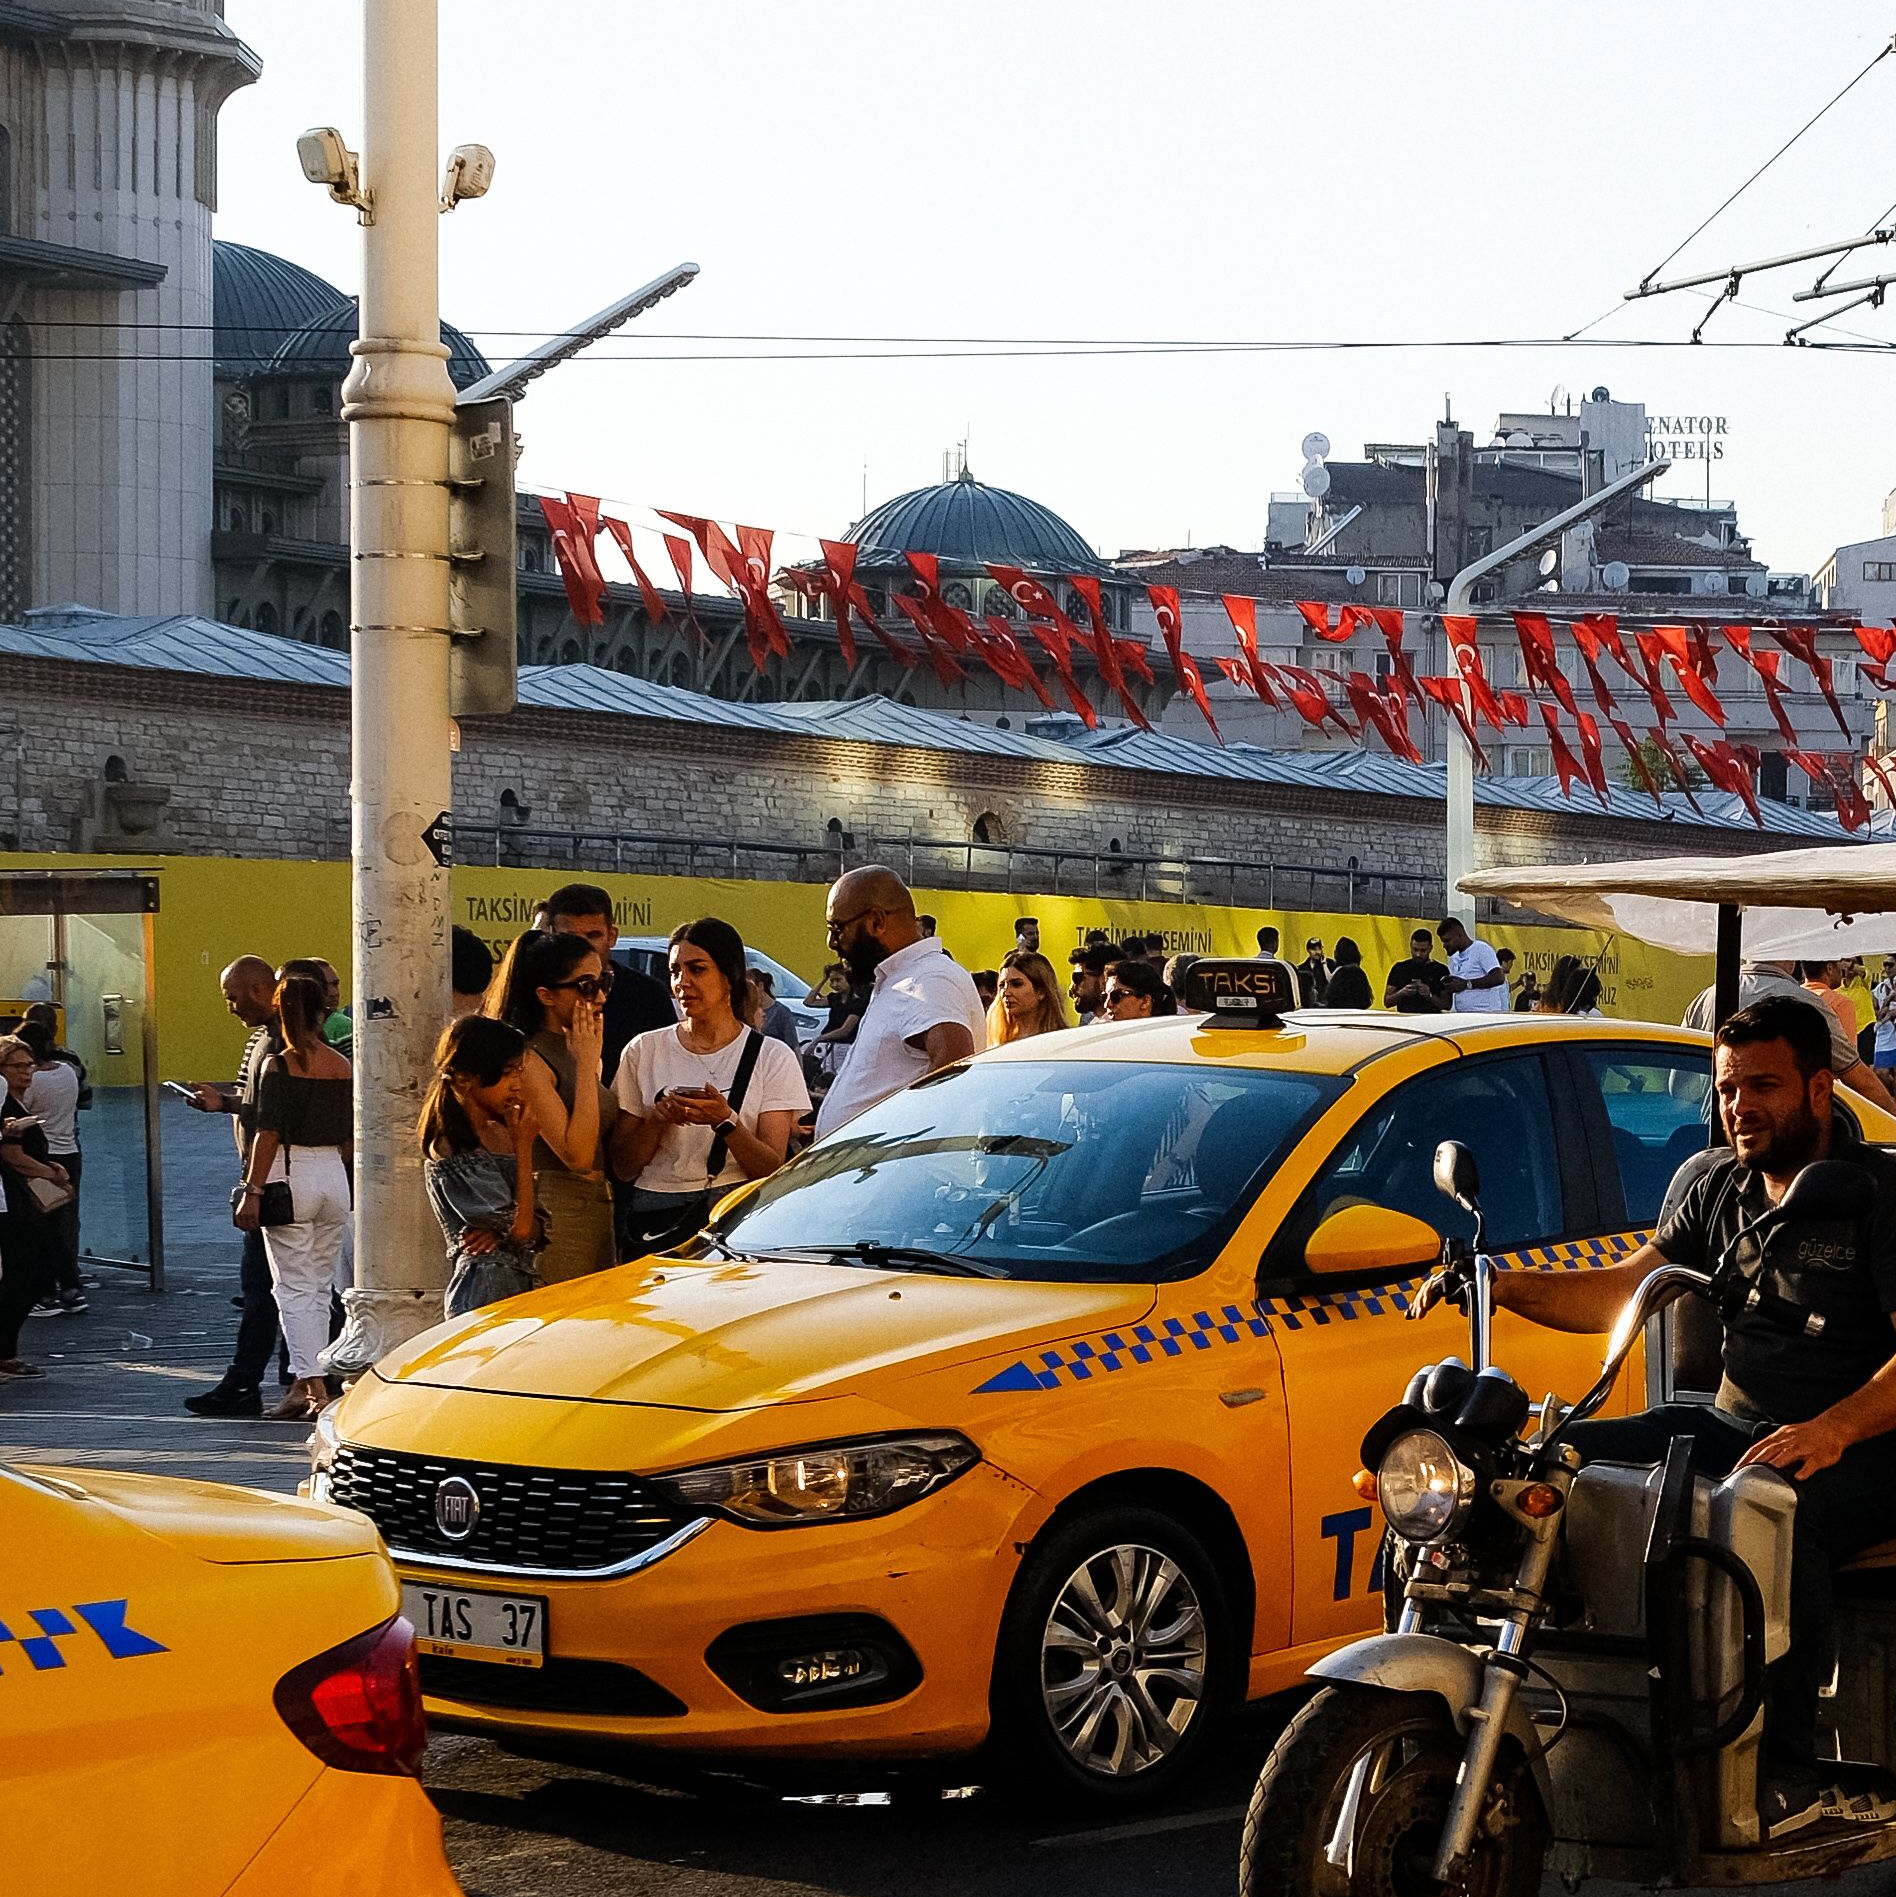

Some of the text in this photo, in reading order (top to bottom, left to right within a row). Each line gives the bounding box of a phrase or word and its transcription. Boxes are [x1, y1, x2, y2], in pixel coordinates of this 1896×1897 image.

[1648, 416, 1730, 435] ENATOR
[445, 1496, 469, 1523] FIAT
[422, 1591, 537, 1648] TAS 37
